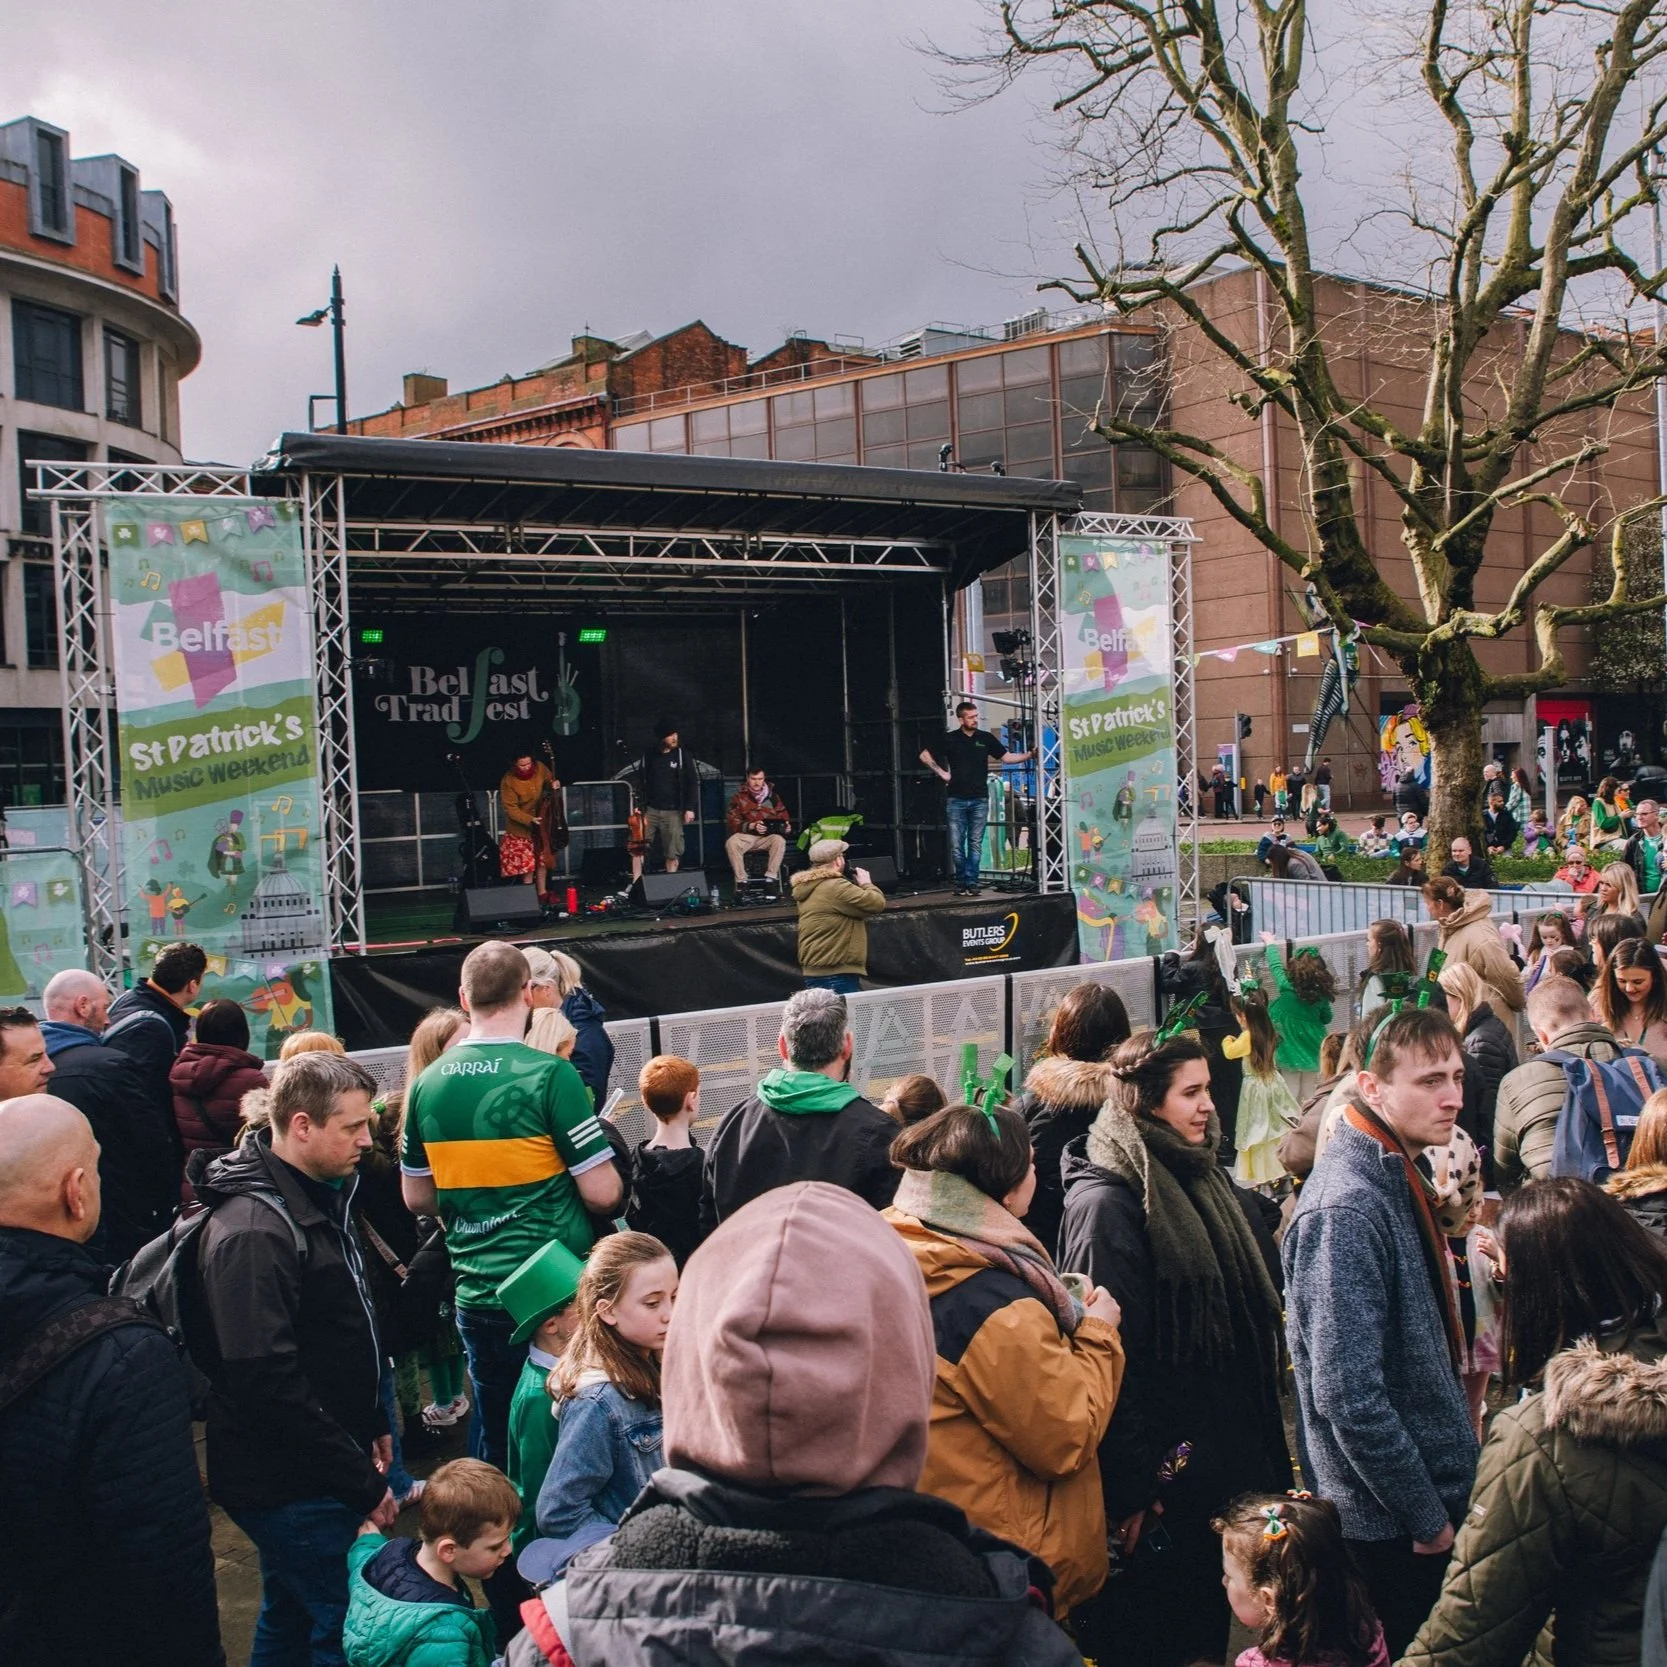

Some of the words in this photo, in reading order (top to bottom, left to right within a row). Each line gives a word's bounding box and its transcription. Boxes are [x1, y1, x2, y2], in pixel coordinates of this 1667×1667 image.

[151, 621, 283, 653] Belfast
[1083, 628, 1150, 652] Belfa
[374, 694, 462, 722] Trad
[1069, 717, 1091, 740] St
[1090, 698, 1166, 735] Patrick's
[129, 740, 166, 771] St
[167, 712, 304, 764] Patrick's
[1072, 737, 1114, 763] Music
[133, 767, 205, 800] Music
[207, 743, 311, 785] Weekend
[962, 925, 1006, 940] BUTLERS
[962, 938, 985, 947] EVENTS
[985, 936, 1006, 945] GROUP
